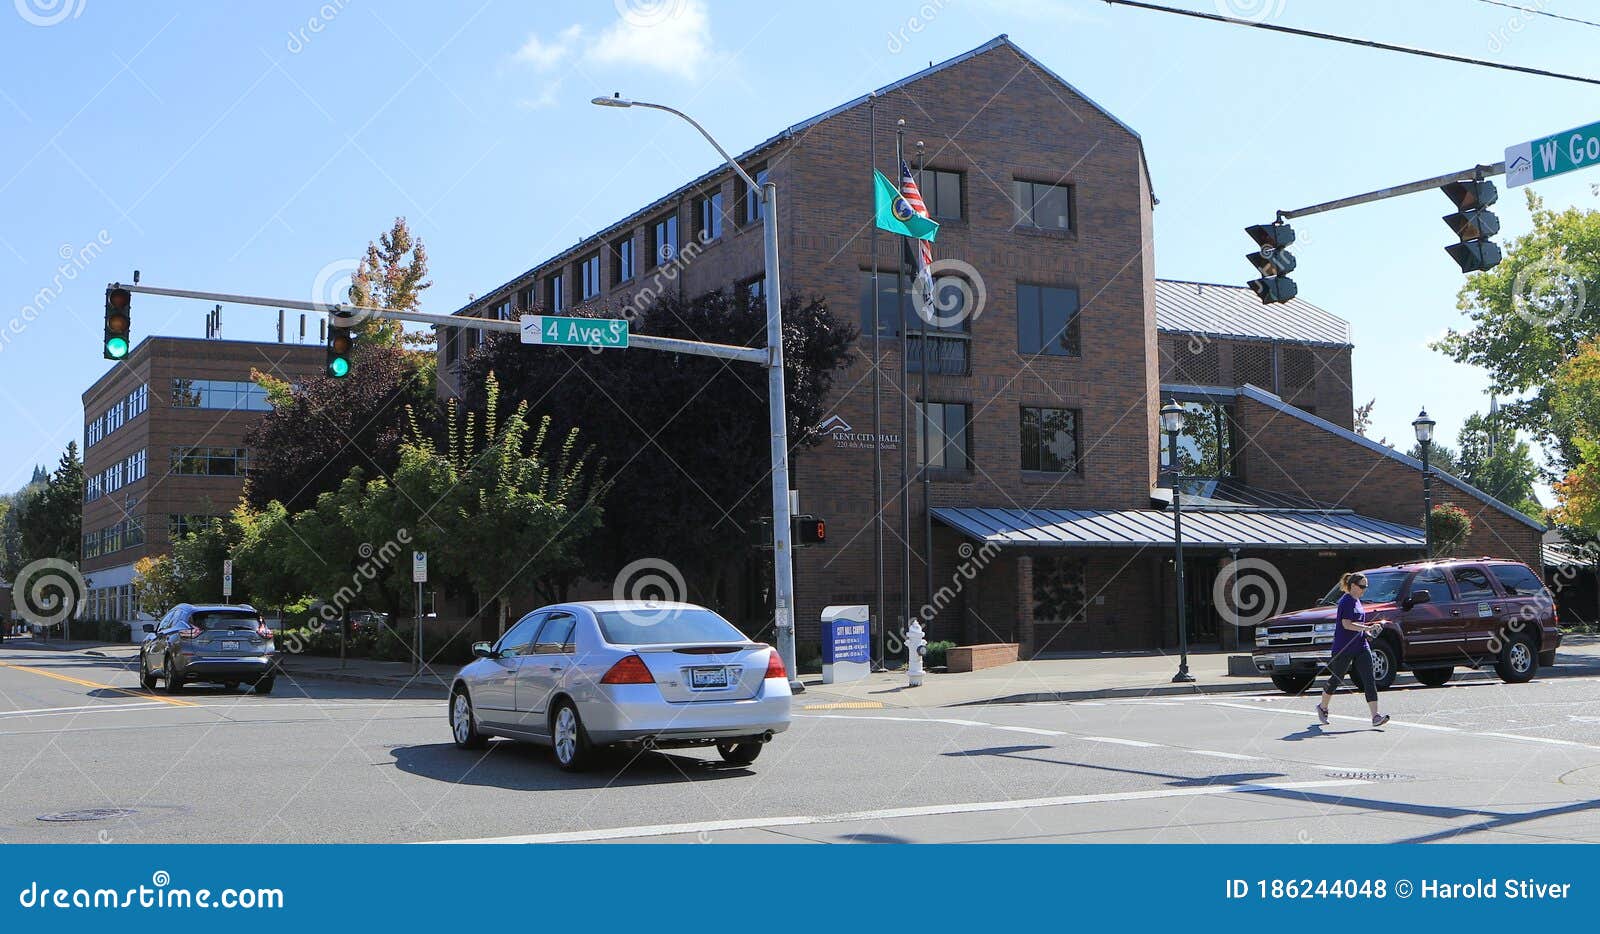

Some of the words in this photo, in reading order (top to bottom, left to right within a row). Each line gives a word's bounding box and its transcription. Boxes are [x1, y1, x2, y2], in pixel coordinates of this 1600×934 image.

[1540, 140, 1557, 173] W
[1569, 133, 1600, 164] Go
[547, 321, 559, 341] 4
[567, 321, 600, 342] Ave
[609, 323, 620, 343] S
[832, 432, 856, 441] KENT
[857, 433, 875, 441] CITY
[878, 434, 900, 442] HALL
